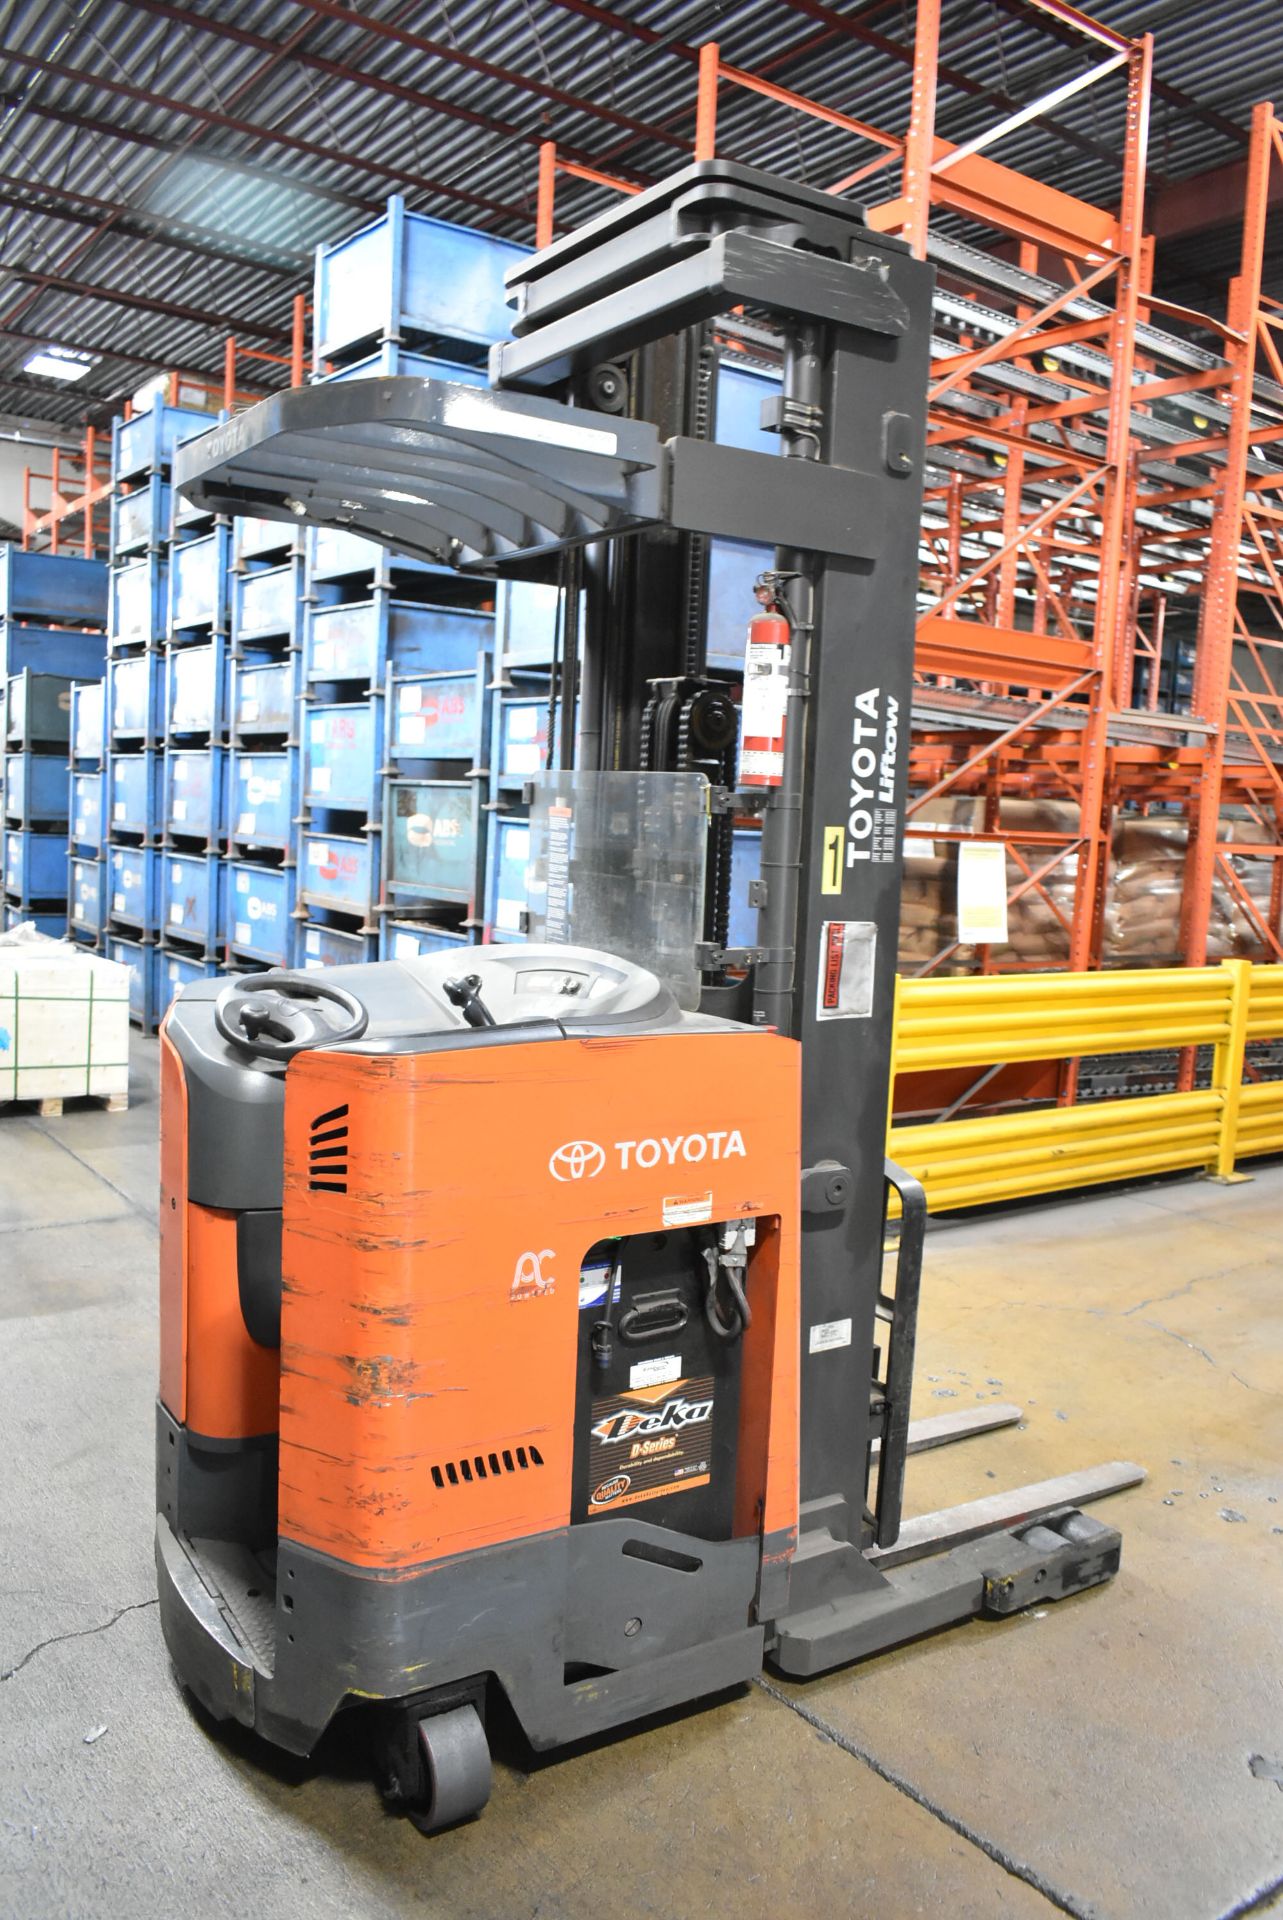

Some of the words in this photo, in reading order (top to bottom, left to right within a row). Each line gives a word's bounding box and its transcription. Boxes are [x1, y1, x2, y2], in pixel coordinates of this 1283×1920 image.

[878, 695, 899, 803] Liftow
[847, 687, 880, 868] TOYOTA
[828, 834, 839, 887] 1
[830, 949, 839, 967] LIST
[827, 969, 838, 1003] PACKING
[614, 1130, 747, 1170] TOYOTA
[511, 1249, 556, 1290] AC
[605, 1401, 711, 1441] Deka
[630, 1436, 677, 1459] D-Series
[596, 1480, 626, 1500] QUALITY
